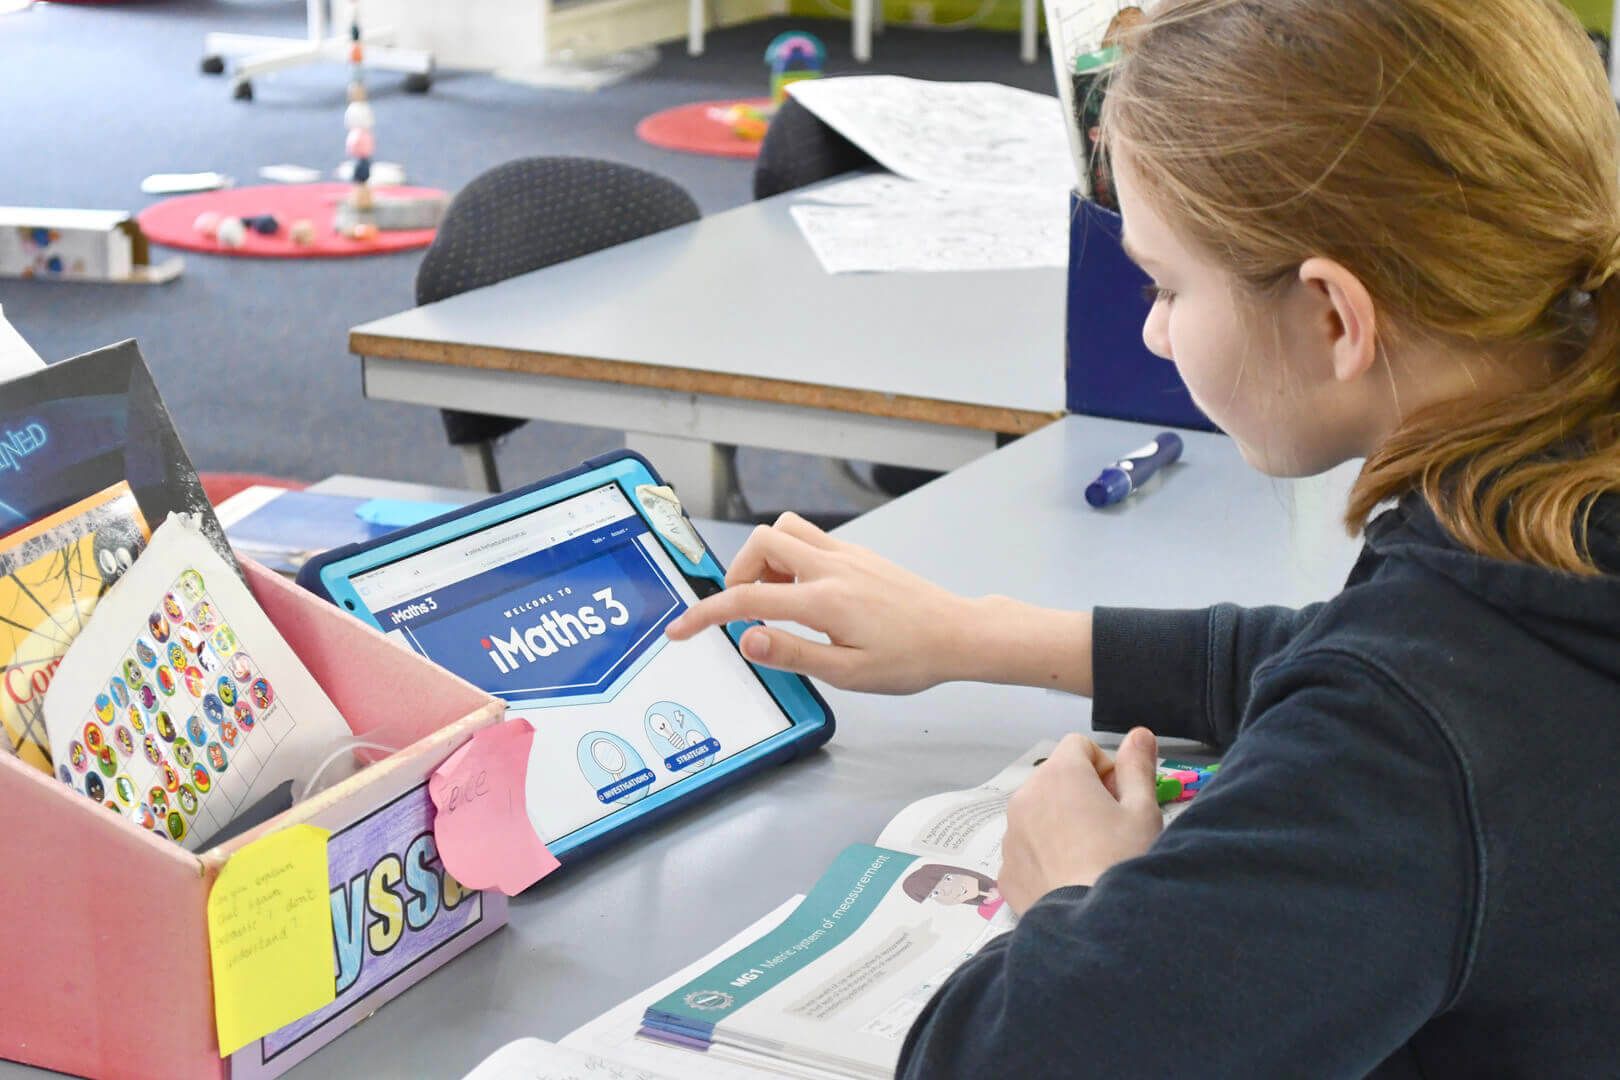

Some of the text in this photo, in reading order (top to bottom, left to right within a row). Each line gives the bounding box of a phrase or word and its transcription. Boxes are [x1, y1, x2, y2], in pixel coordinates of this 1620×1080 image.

[390, 597, 438, 624] iMaths 3
[504, 586, 573, 618] WELCOME TO
[481, 587, 630, 674] iMaths 3
[676, 745, 709, 765] STRATEGIES
[604, 773, 649, 799] INVESTIGATIONS
[730, 968, 764, 987] MG1
[823, 918, 836, 929] of
[832, 854, 891, 919] measurement
